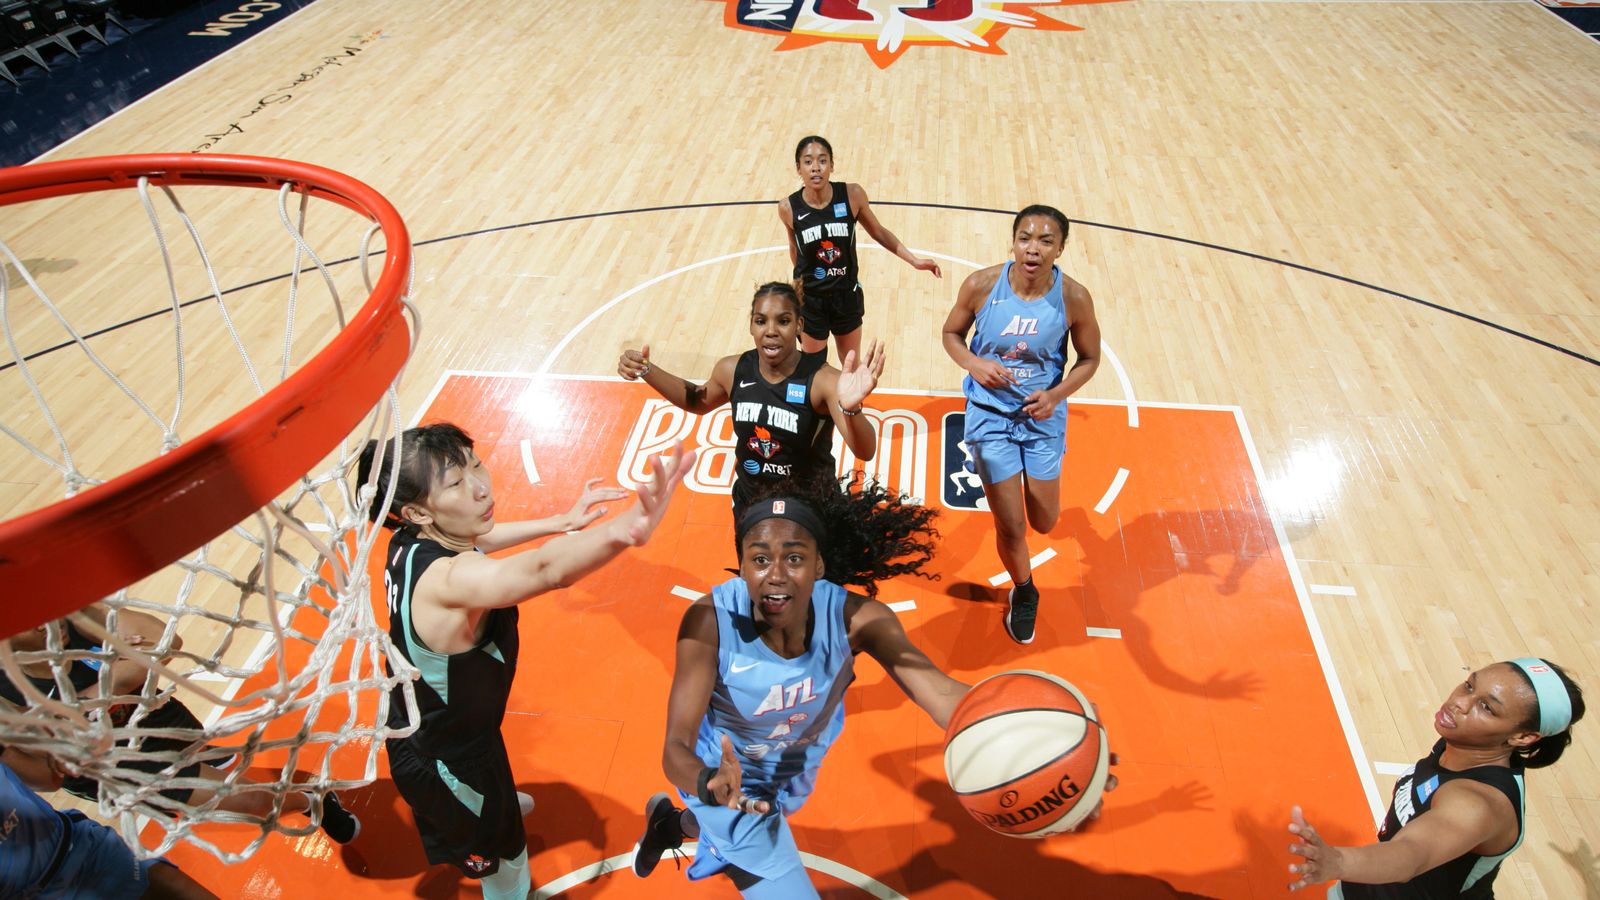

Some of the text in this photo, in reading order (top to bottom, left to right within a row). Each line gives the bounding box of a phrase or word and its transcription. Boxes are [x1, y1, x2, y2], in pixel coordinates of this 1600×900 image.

[801, 222, 849, 245] NEW YORK
[826, 266, 847, 276] AT&T
[1000, 314, 1039, 336] ATL
[788, 389, 804, 398] HSS
[735, 402, 799, 434] NEW YORK
[762, 462, 793, 477] AT&T
[752, 676, 817, 717] ATL
[980, 774, 1080, 828] PALDING
